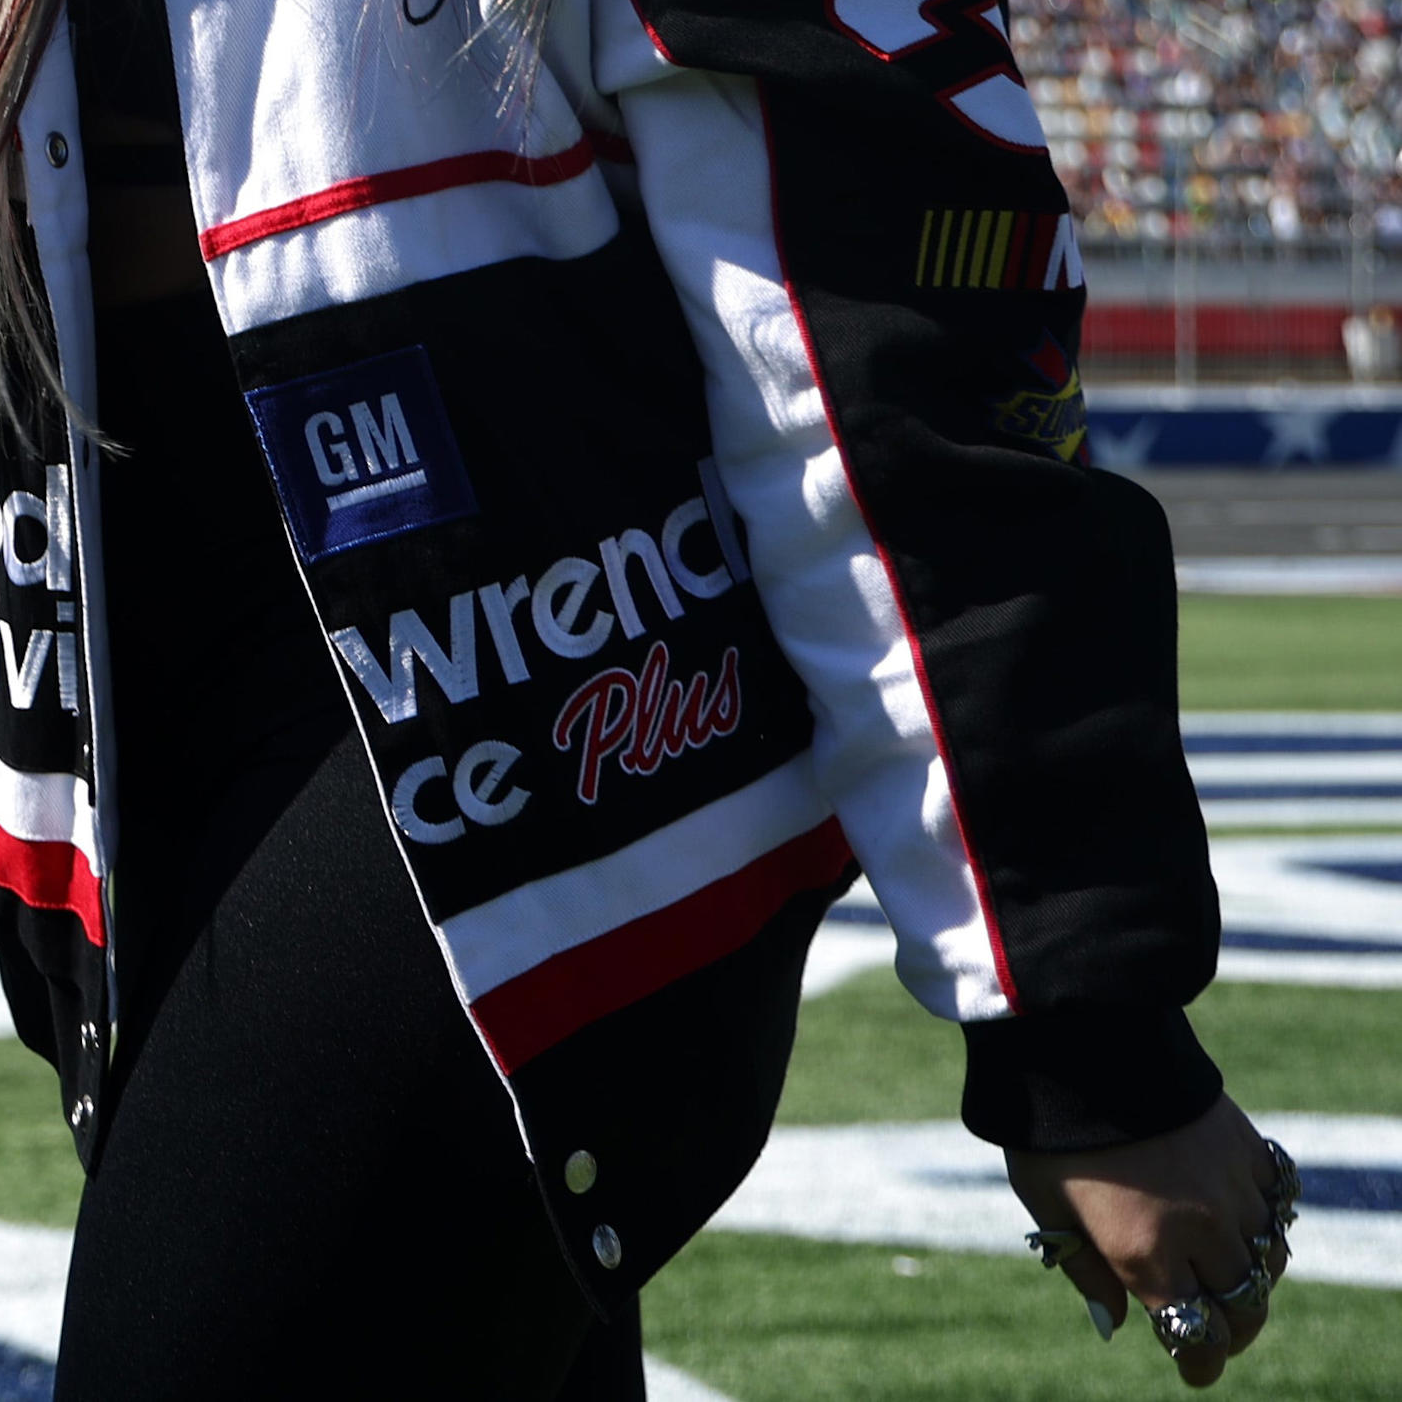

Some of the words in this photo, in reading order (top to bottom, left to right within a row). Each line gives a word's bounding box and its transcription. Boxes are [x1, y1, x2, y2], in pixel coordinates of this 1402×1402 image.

[304, 392, 422, 487] GM
[391, 740, 532, 845] ce
[552, 640, 742, 805] Plus
